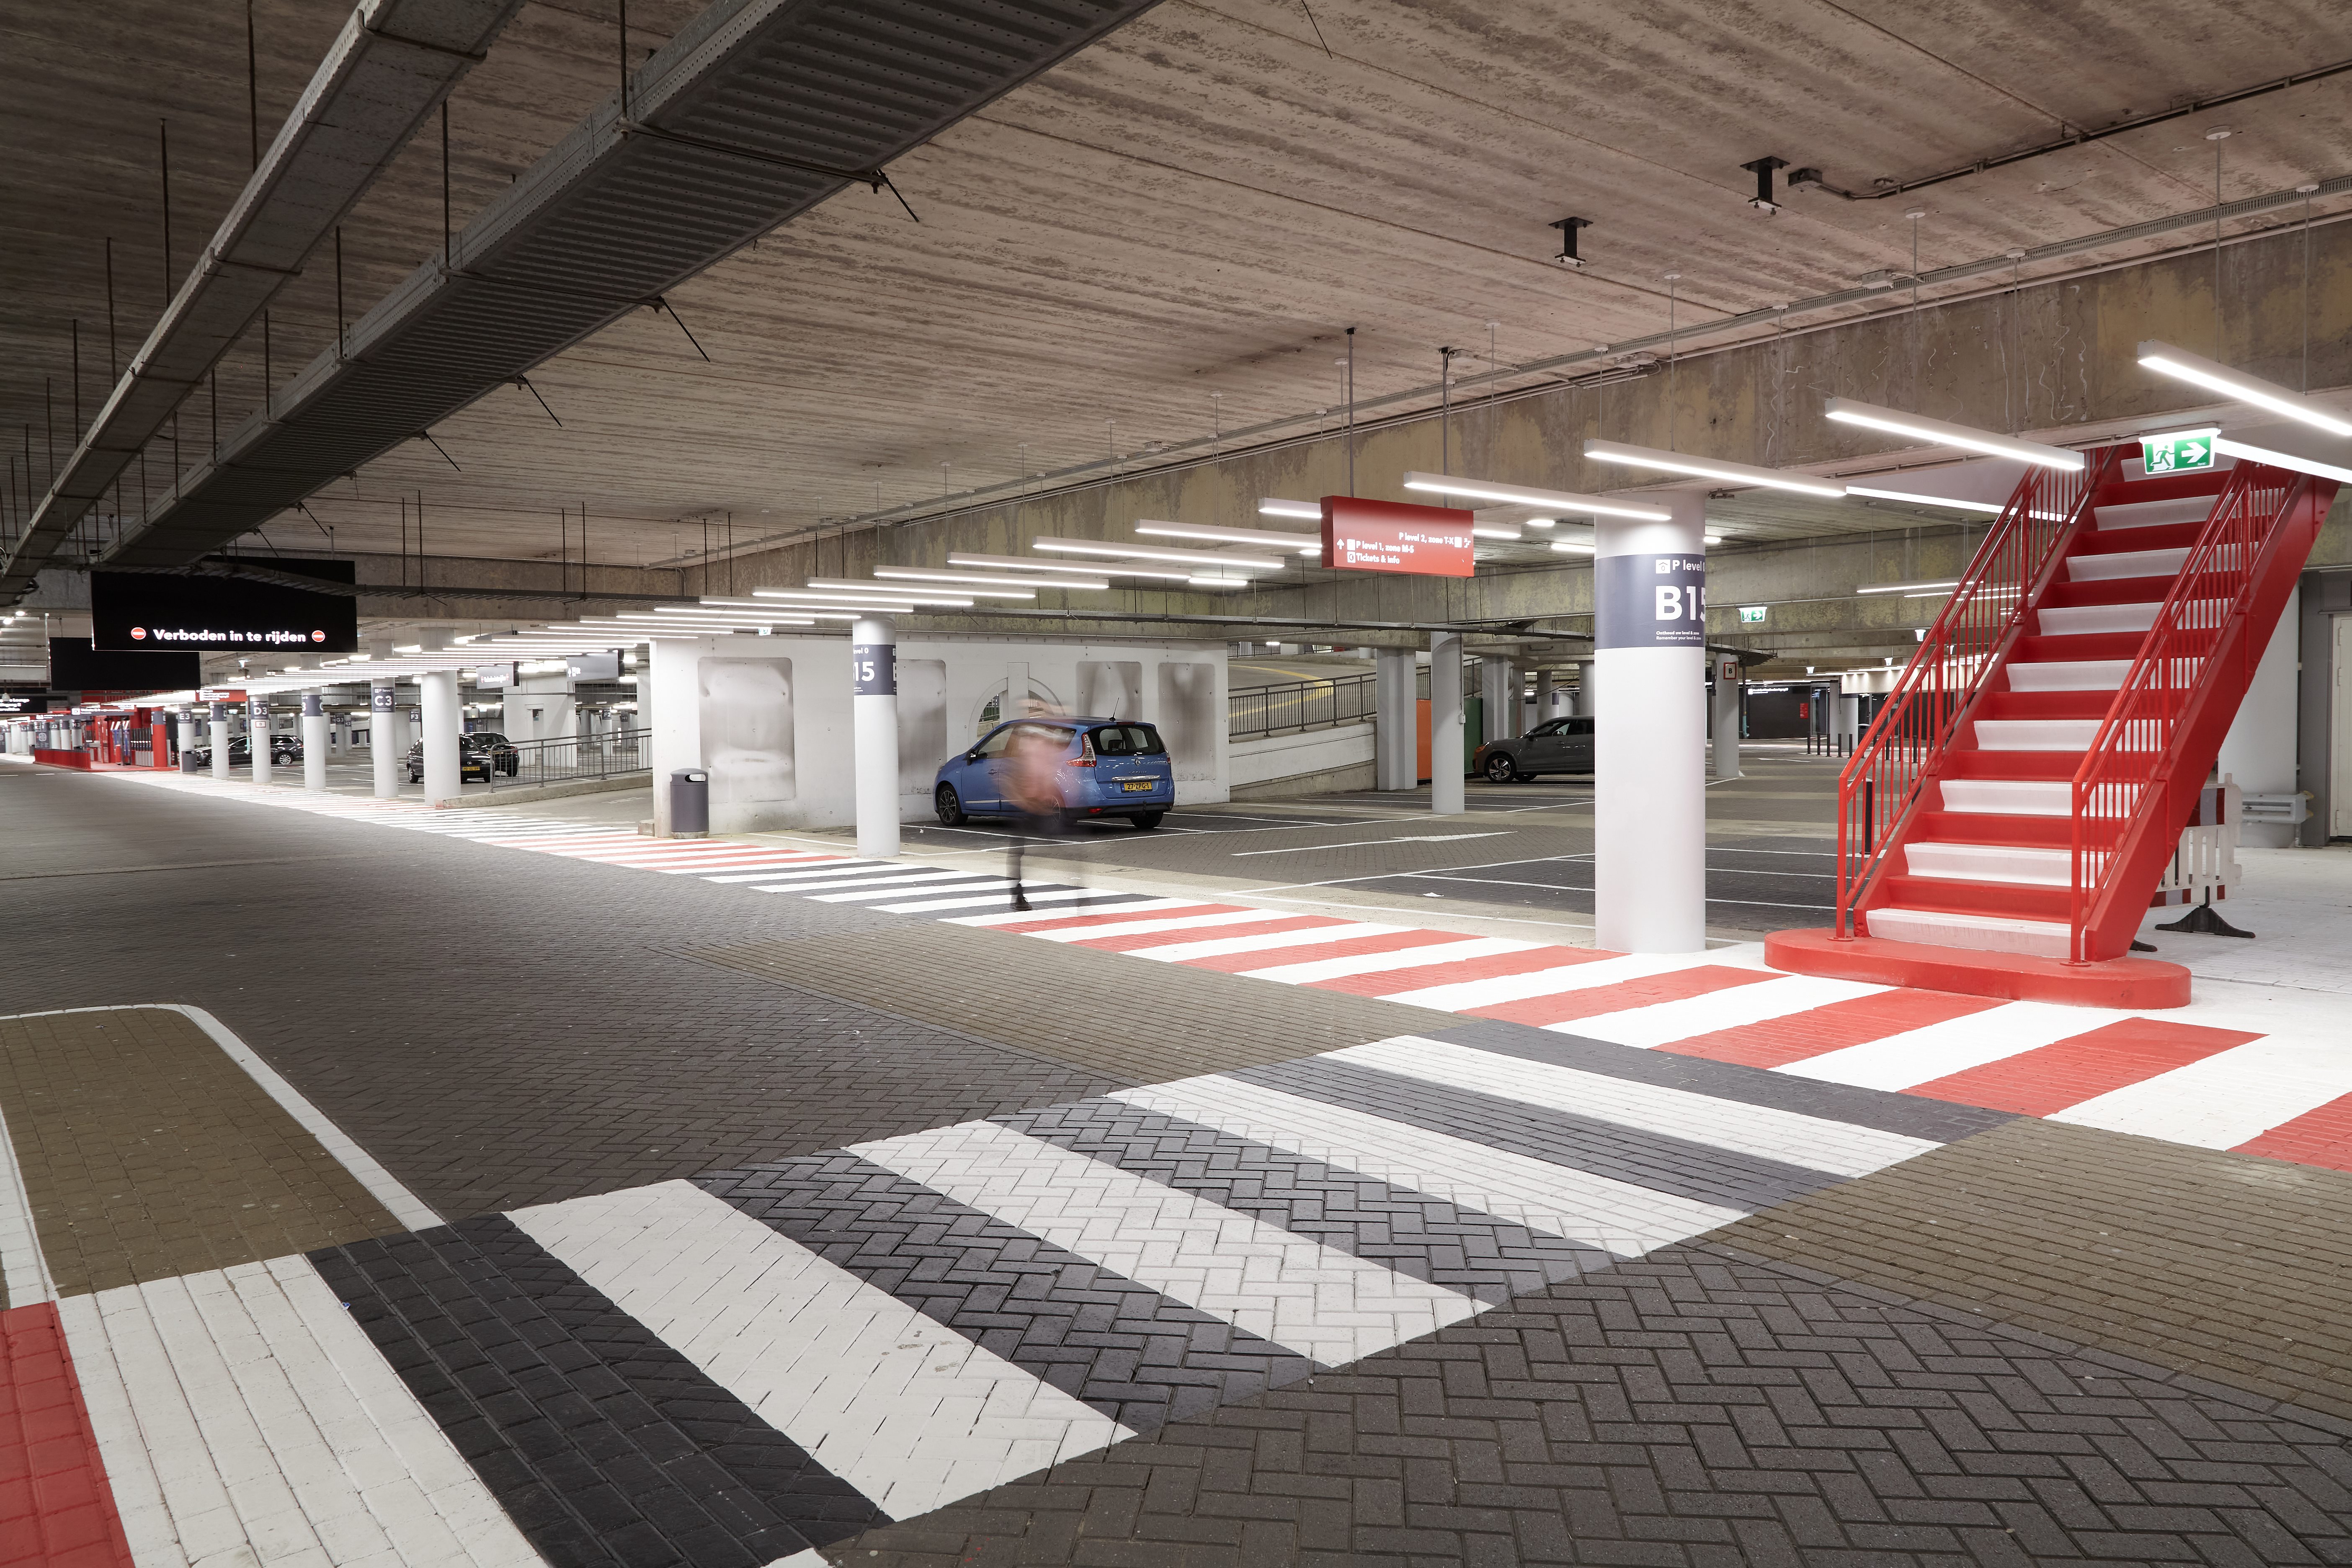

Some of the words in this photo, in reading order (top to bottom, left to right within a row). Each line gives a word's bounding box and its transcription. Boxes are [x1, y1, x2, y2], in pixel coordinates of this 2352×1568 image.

[1405, 532, 1420, 542] level
[1421, 534, 1427, 543] 2,
[1362, 541, 1377, 550] level
[1379, 542, 1384, 552] 1,
[1402, 544, 1414, 553] M-S
[1356, 553, 1380, 562] Tickets
[1381, 554, 1386, 563] &
[1387, 555, 1400, 564] info
[1672, 560, 1680, 570] P
[1683, 560, 1702, 571] level
[153, 629, 226, 641] Verboden
[230, 631, 243, 641] in
[246, 632, 262, 642] te
[266, 631, 306, 645] rijden
[853, 661, 875, 681] 15
[374, 695, 392, 706] C3
[253, 707, 267, 715] D3
